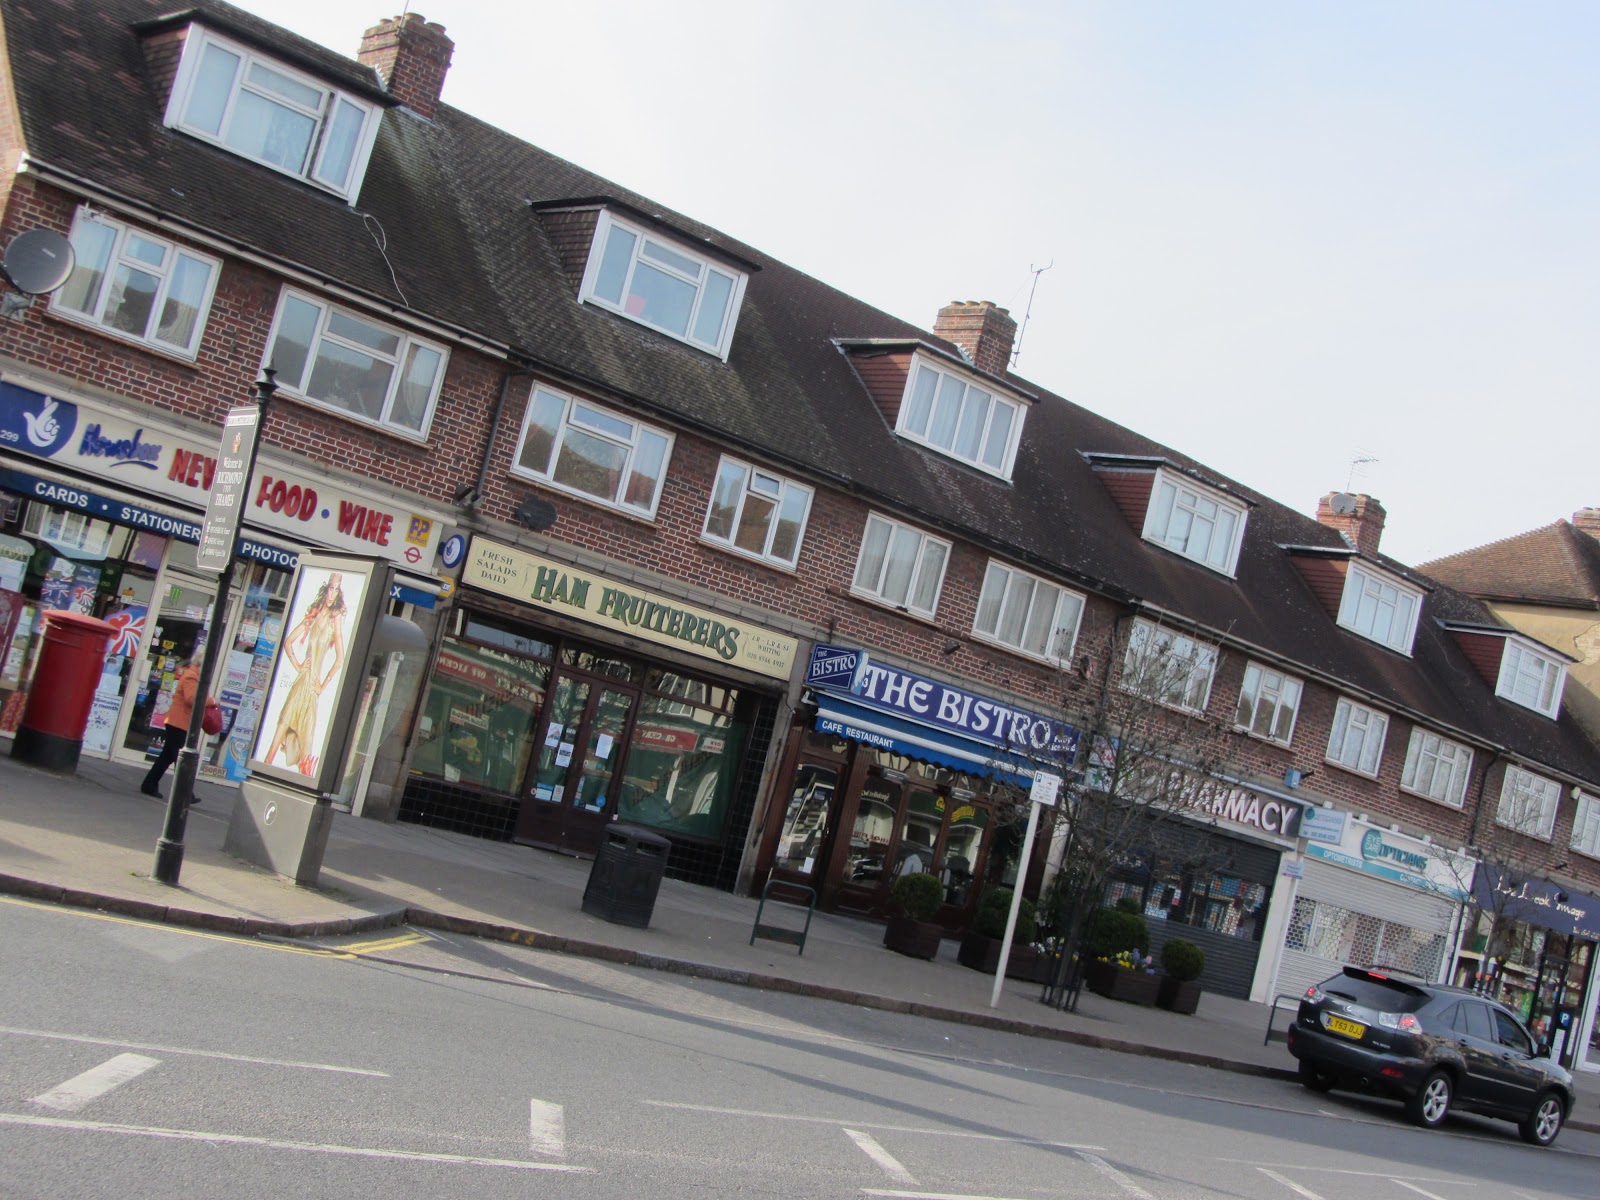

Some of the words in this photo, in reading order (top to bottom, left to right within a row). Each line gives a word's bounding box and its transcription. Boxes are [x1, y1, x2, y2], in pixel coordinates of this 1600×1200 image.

[0, 429, 19, 443] 299
[35, 482, 89, 507] CARDS
[120, 507, 202, 539] STATIONER
[255, 475, 318, 521] FOOD
[337, 500, 394, 547] WINE
[482, 550, 513, 565] FRESH
[477, 559, 518, 577] SALADS
[480, 570, 508, 585] DAILY
[530, 565, 592, 609] HAM
[598, 588, 740, 660] FRUITERERS
[746, 651, 758, 660] 020
[816, 650, 828, 658] THE
[812, 655, 857, 677] BISTRO
[862, 677, 869, 688] 3
[864, 664, 934, 713] THE
[935, 688, 1052, 751] BISTRO
[821, 720, 843, 733] CAFE
[845, 727, 895, 749] RESTAURANT
[204, 765, 227, 776] SORRY
[1364, 841, 1381, 854] CARE
[1367, 834, 1382, 845] EYE
[1322, 848, 1364, 869] OPTOMETRISTS
[1379, 843, 1428, 870] OPTICIANS
